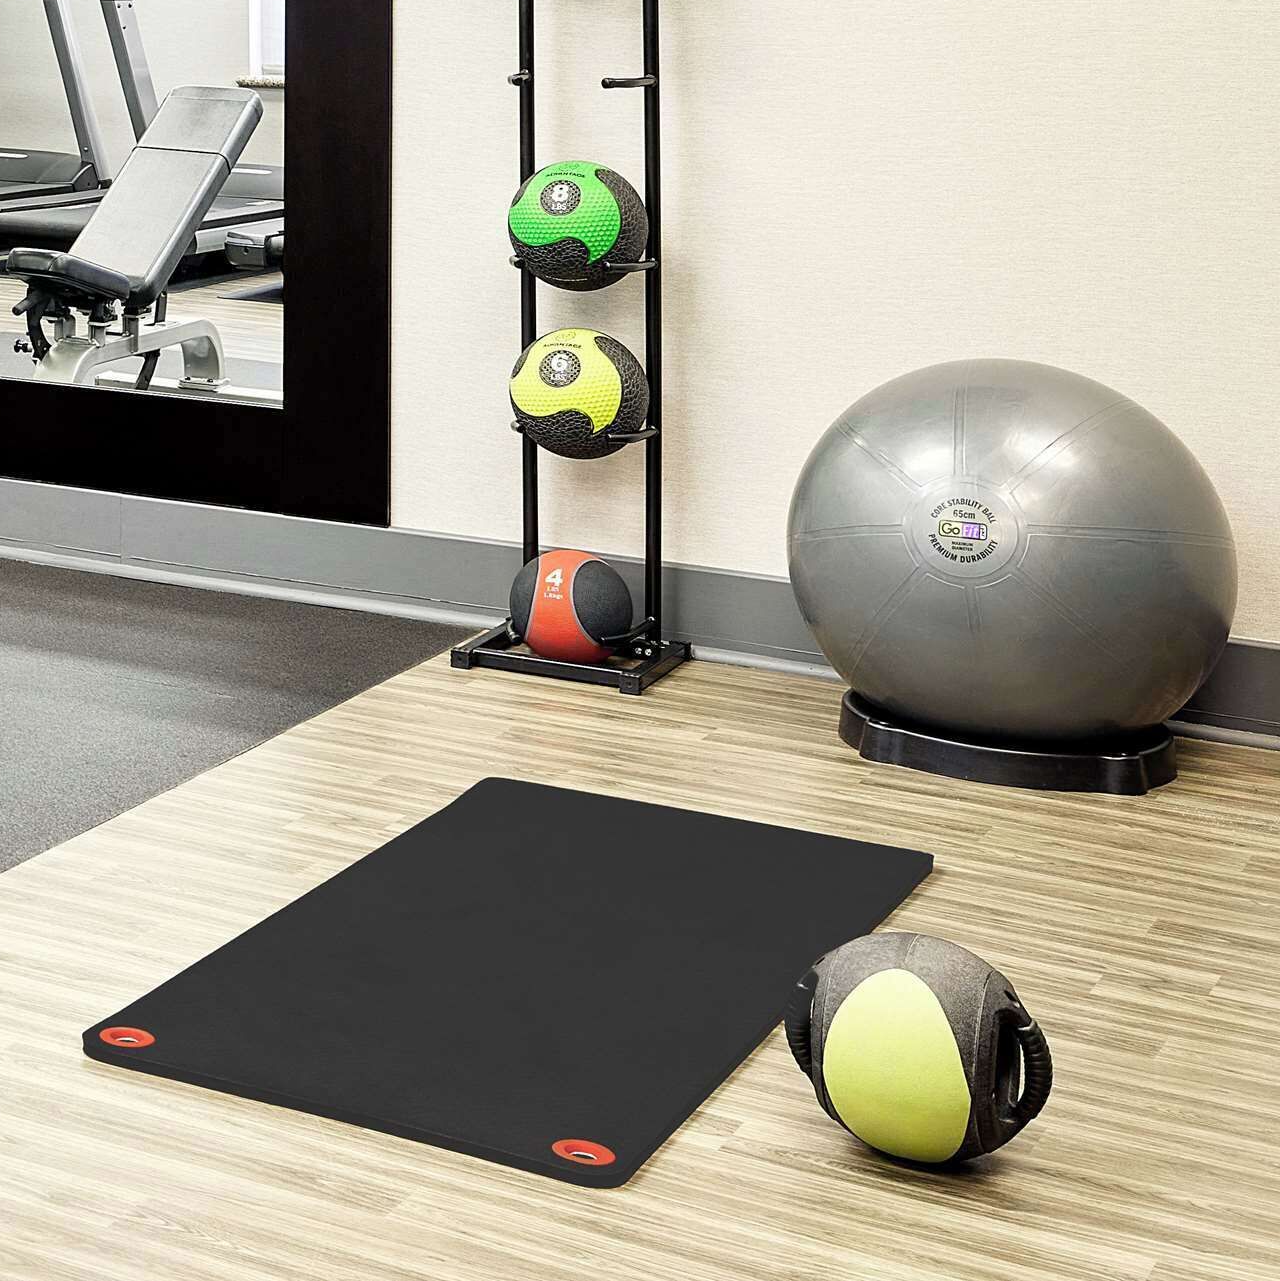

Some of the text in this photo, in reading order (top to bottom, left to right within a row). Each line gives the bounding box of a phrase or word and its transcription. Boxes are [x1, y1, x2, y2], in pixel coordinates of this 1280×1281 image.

[551, 184, 569, 202] 8
[551, 203, 567, 211] LBS
[550, 353, 569, 372] 6
[931, 498, 996, 523] CORE STABILITY BALL
[953, 509, 976, 520] 65cm
[929, 533, 998, 563] PREMIUM DURABILITY
[544, 568, 564, 587] 4
